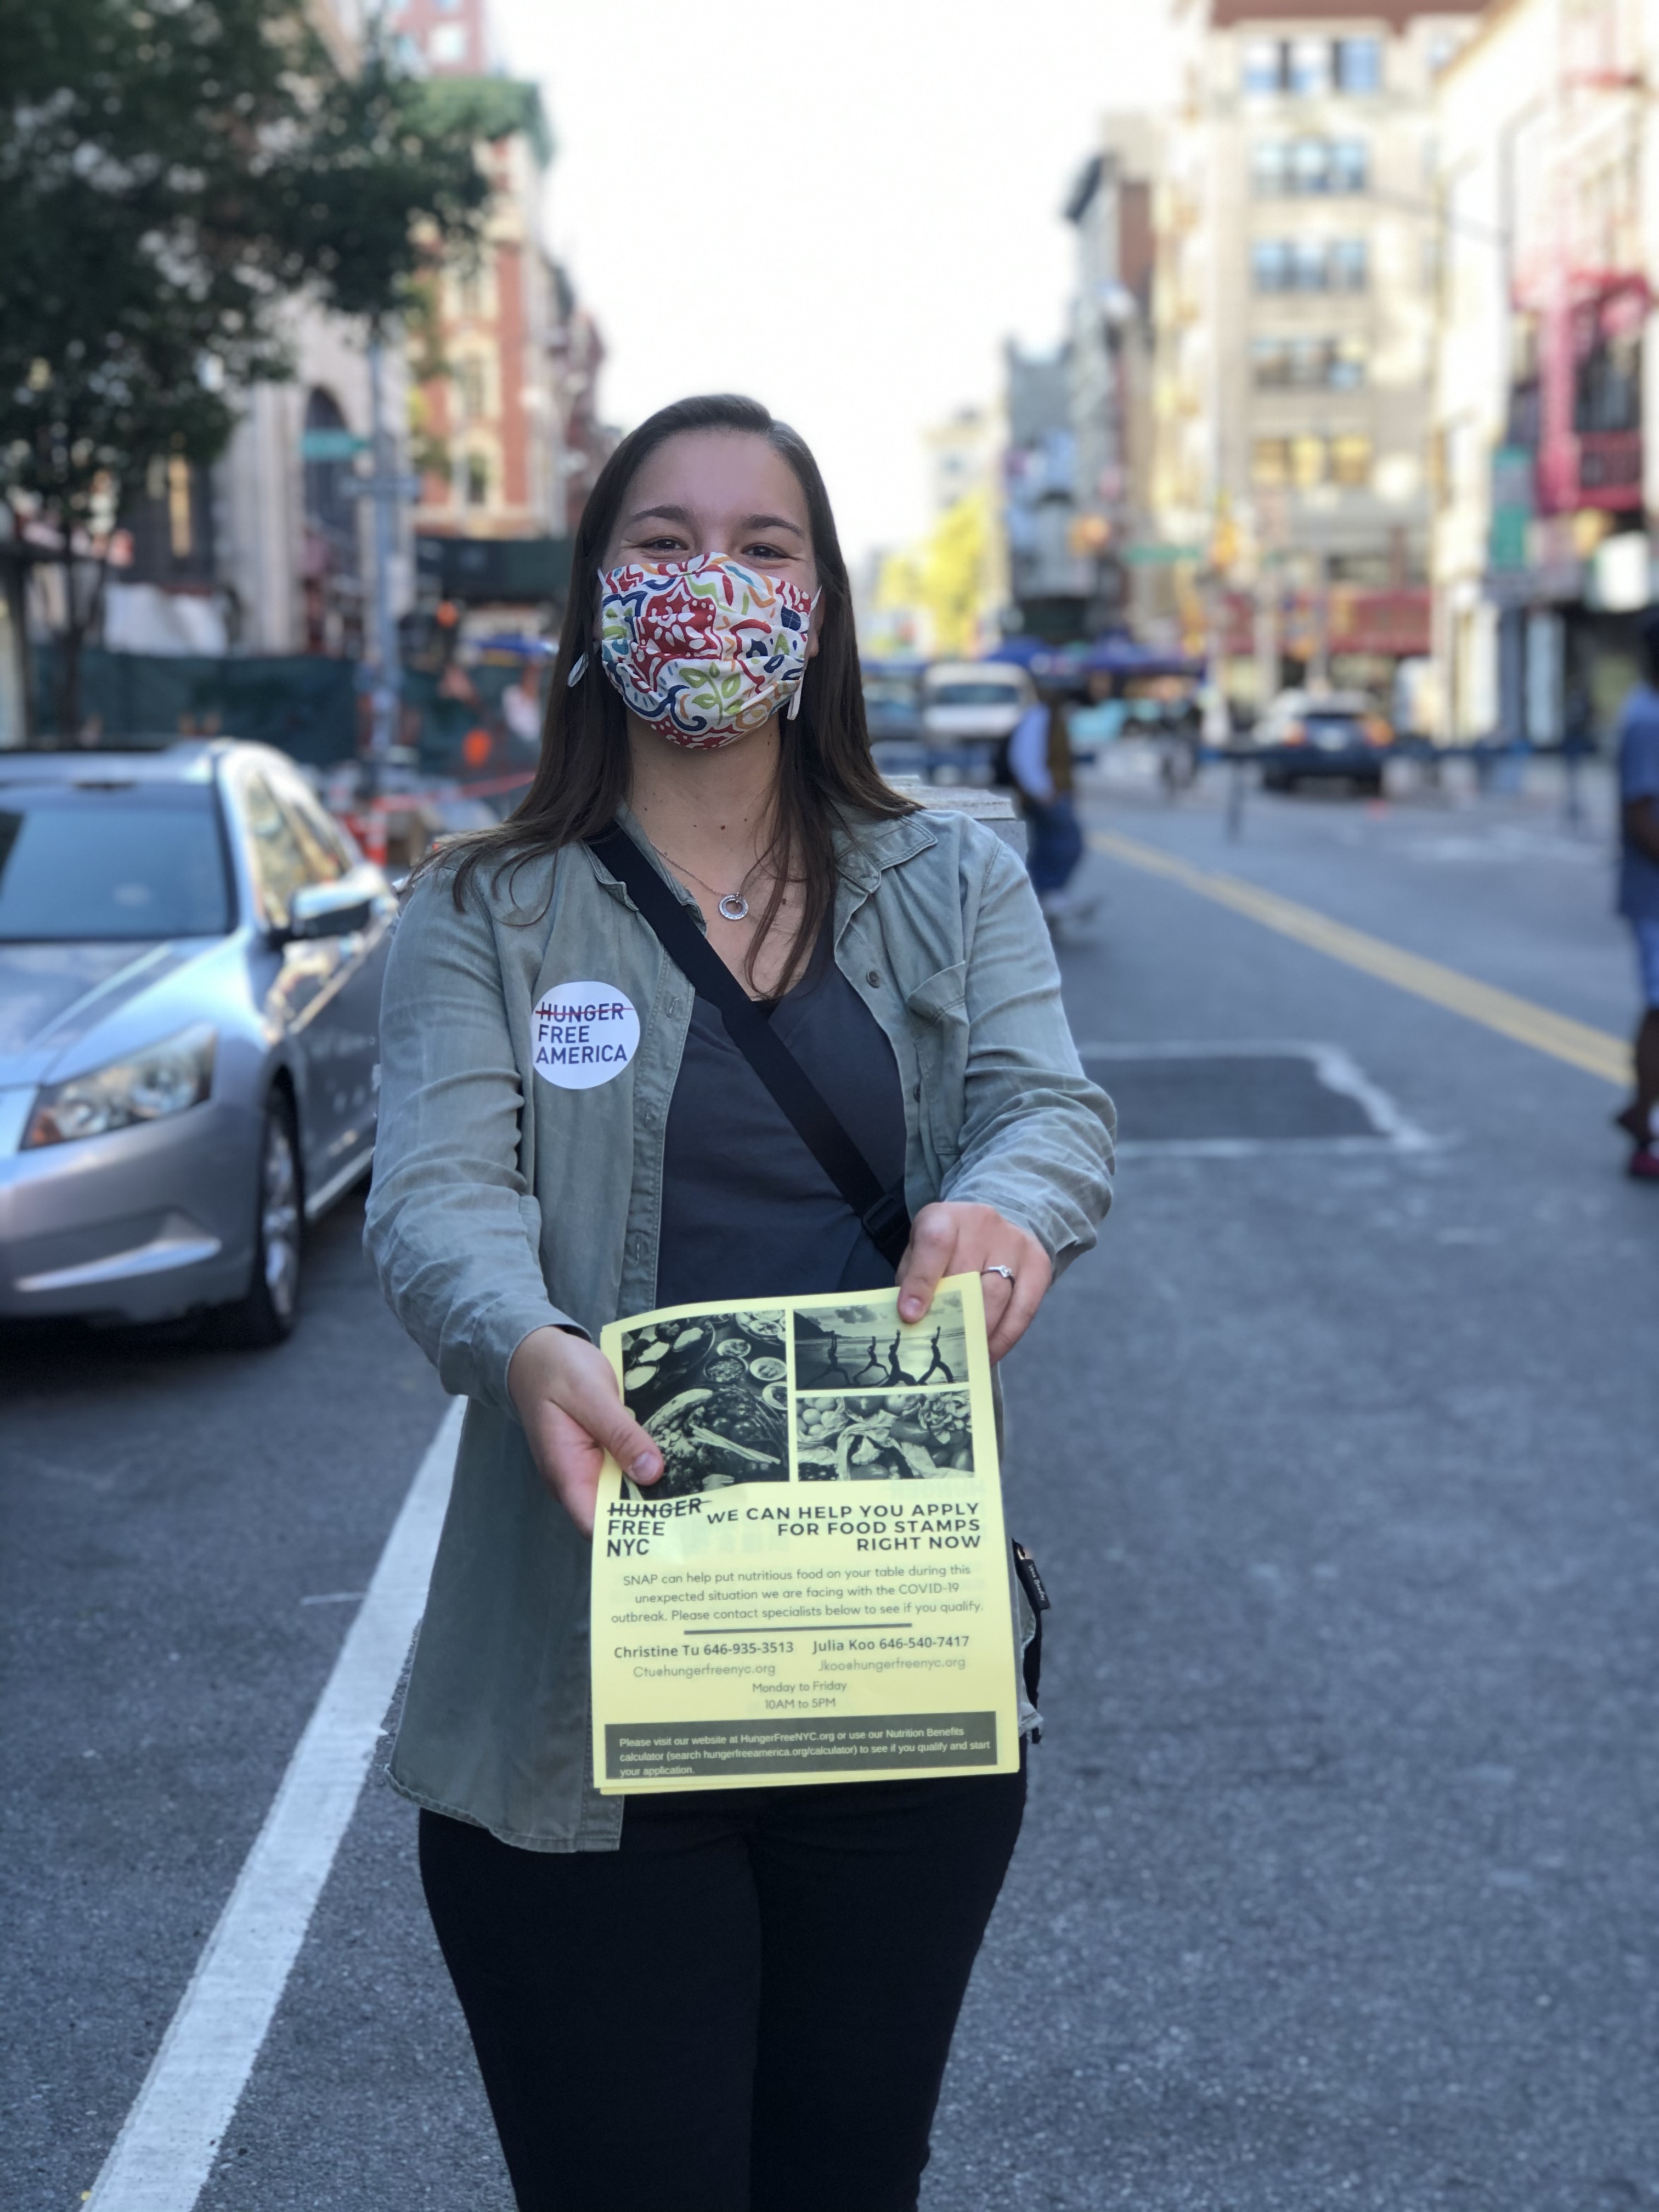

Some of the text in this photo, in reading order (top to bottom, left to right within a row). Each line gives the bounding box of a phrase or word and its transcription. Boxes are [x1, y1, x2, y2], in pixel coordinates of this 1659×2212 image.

[540, 1002, 624, 1023] HUNGER
[538, 1024, 590, 1043] FREE
[535, 1044, 628, 1064] AMERICA
[609, 1498, 702, 1519] HUNGER
[707, 1503, 979, 1524] WE CAN HELP YOU APPLY
[608, 1520, 665, 1536] FREE
[778, 1519, 980, 1536] FOR FOOD STAMPS
[607, 1539, 650, 1557] NYC
[857, 1536, 981, 1551] RIGHT NOW
[623, 1565, 970, 1585] SNAP can help put nutritious food on your table during this
[635, 1583, 960, 1604] unexpected situation we are facing with the COVID-19
[611, 1601, 983, 1623] outbreak. Please contact specialists below to see if you qualify.
[614, 1641, 794, 1658] Christine Tu 646-935-3513
[812, 1636, 969, 1655] Julia Koo 646-540-7417
[752, 1680, 847, 1694] Monday to Friday
[764, 1698, 836, 1709] 10AM to 5PM
[619, 1737, 651, 1747] Please
[653, 1736, 672, 1746] visit
[692, 1735, 726, 1745] website
[729, 1735, 738, 1744] at
[741, 1731, 835, 1745] HungerFreeNYC.org
[849, 1731, 865, 1740] use
[868, 1730, 883, 1739] our
[886, 1729, 924, 1738] Nutrition
[927, 1728, 964, 1737] Benefits
[619, 1752, 664, 1762] calculator
[667, 1751, 701, 1762] (search
[860, 1745, 868, 1754] to
[871, 1745, 888, 1753] see
[890, 1743, 895, 1753] if
[898, 1745, 915, 1754] you
[917, 1742, 947, 1753] qualify
[950, 1741, 967, 1750] and
[970, 1740, 990, 1750] start
[620, 1765, 695, 1778] your application.
